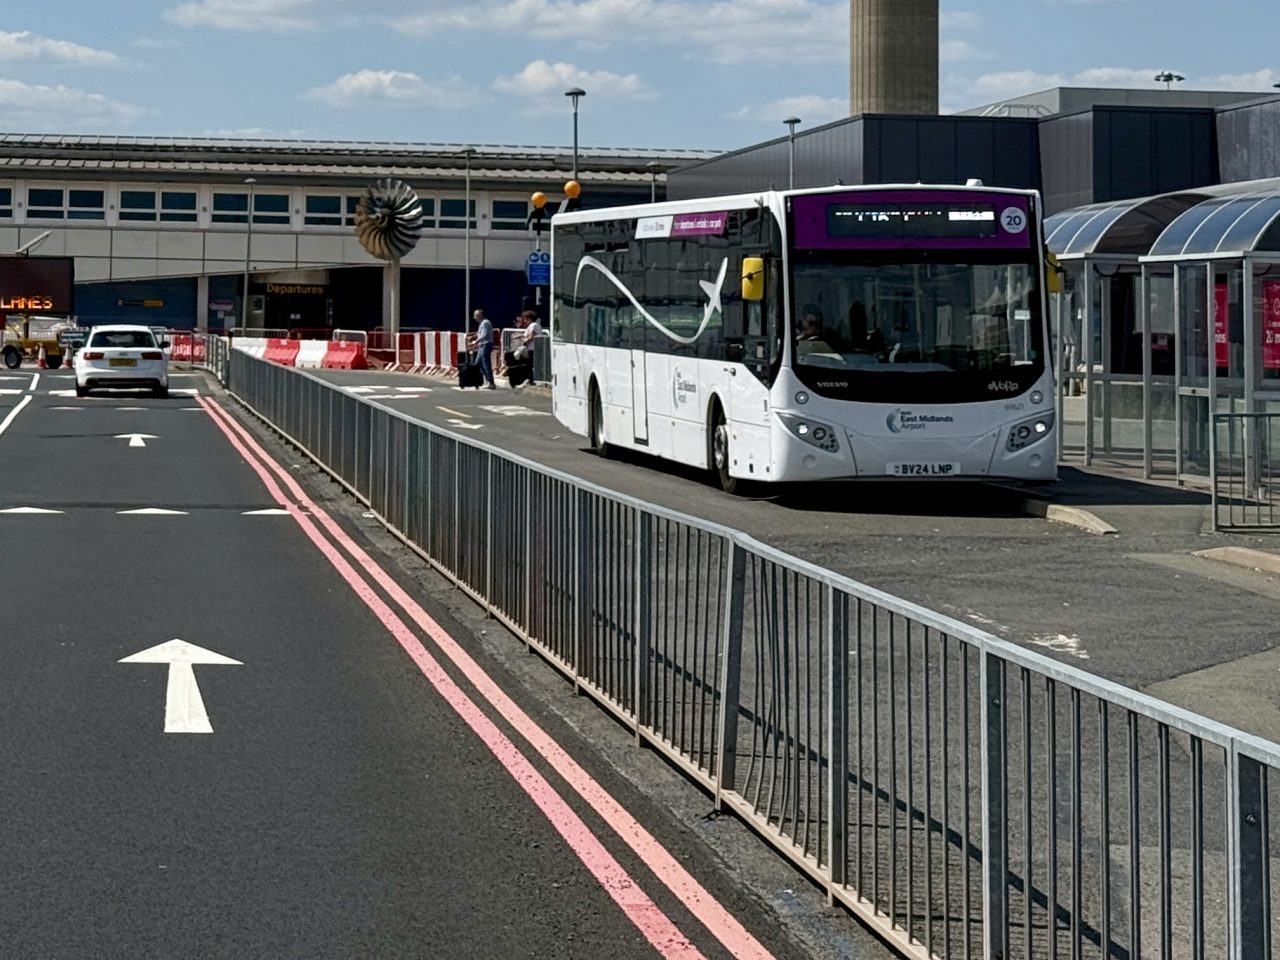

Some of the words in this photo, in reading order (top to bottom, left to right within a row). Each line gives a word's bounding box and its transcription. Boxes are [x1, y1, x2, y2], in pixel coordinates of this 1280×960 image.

[1006, 215, 1022, 226] 20
[267, 283, 323, 294] Departures
[0, 296, 53, 309] LANES
[901, 463, 929, 475] BV24
[931, 463, 953, 475] LNP
